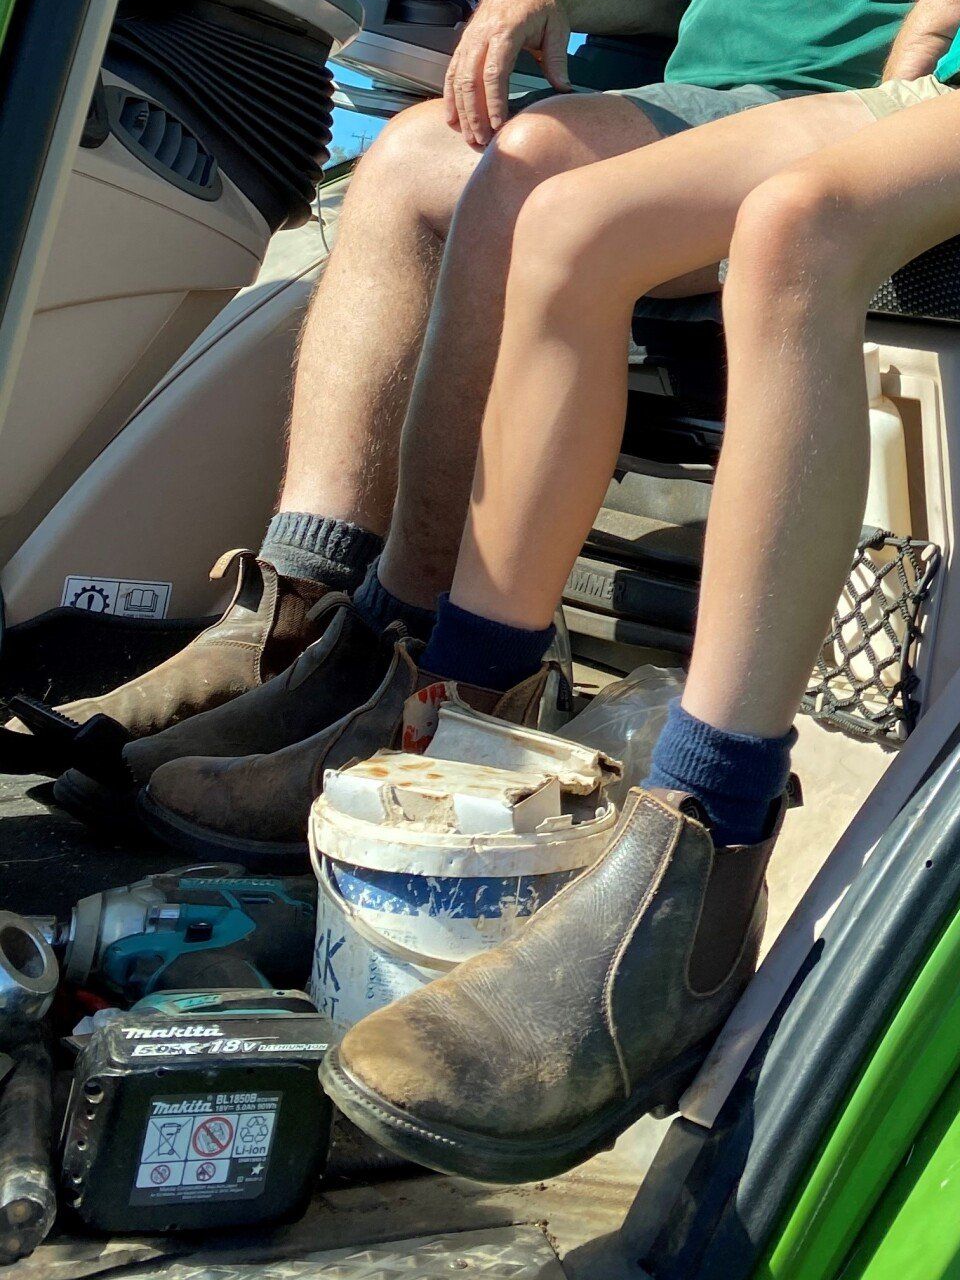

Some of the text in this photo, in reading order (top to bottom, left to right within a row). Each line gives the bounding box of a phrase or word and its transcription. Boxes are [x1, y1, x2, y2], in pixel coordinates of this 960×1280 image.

[122, 1025, 226, 1039] makita
[216, 1093, 257, 1104] BL1850B
[152, 1100, 213, 1114] makita
[235, 1146, 266, 1155] Li-ion
